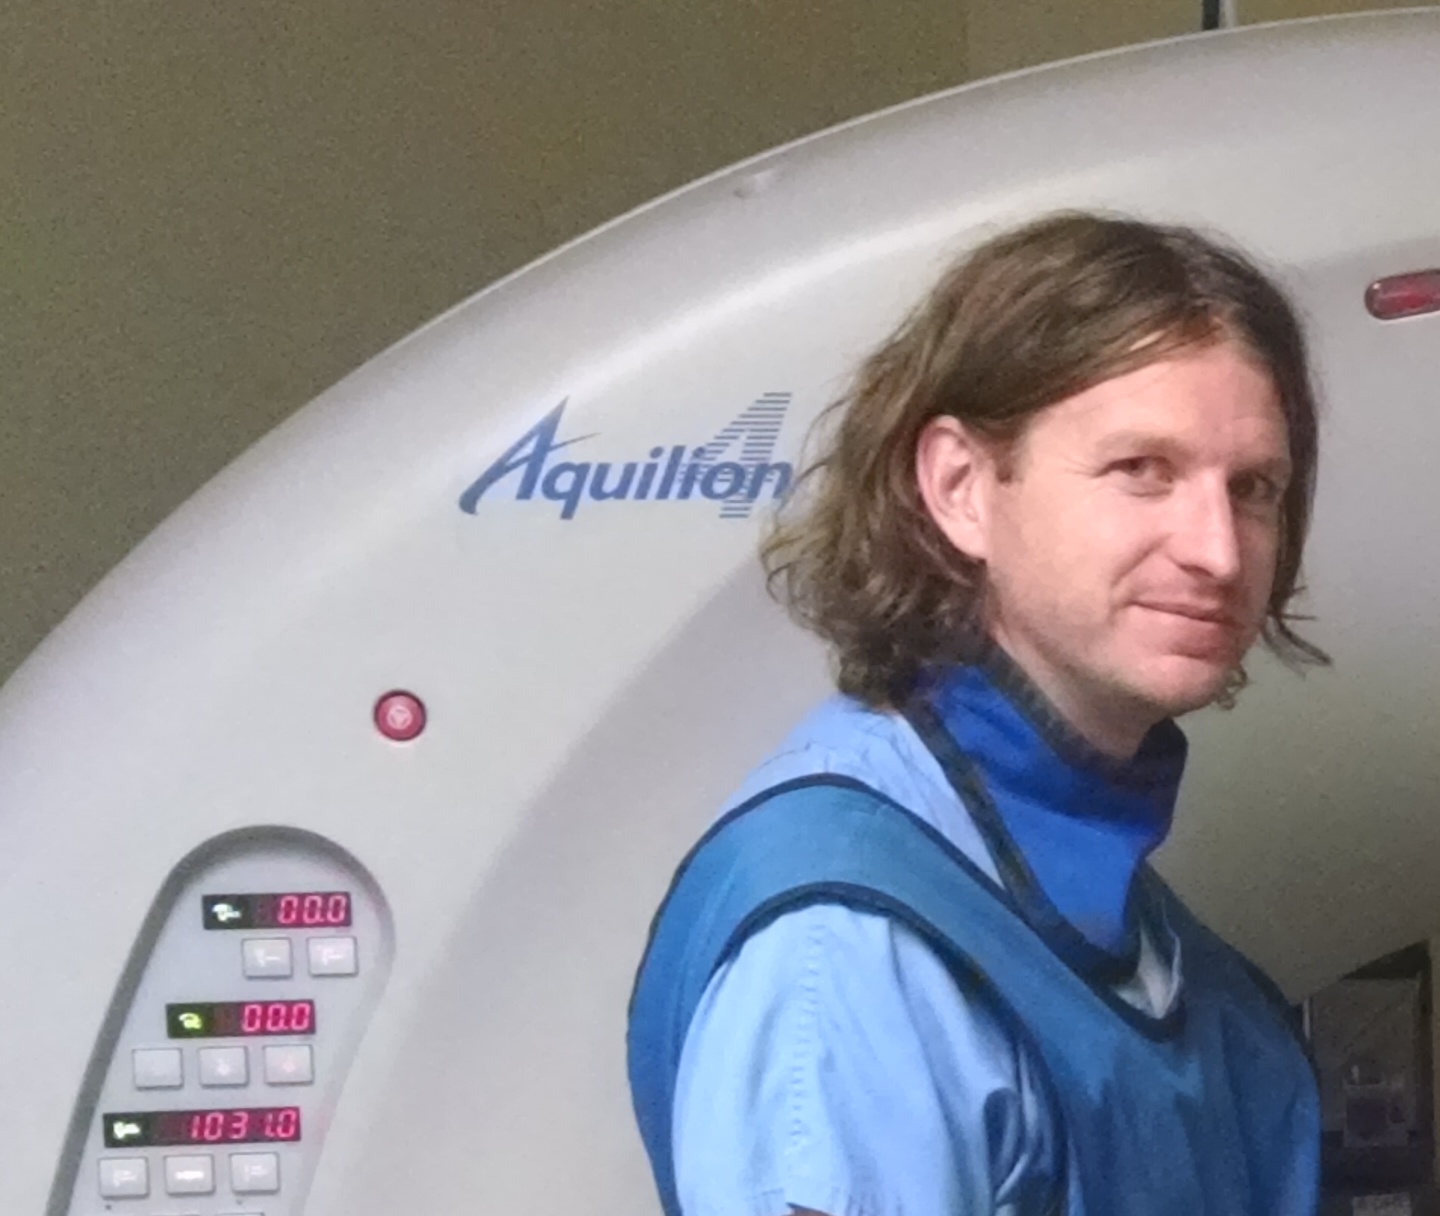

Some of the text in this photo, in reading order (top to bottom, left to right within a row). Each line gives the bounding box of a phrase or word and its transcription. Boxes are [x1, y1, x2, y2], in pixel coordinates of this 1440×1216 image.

[458, 395, 794, 520] Aquilion
[277, 895, 348, 925] 00.0
[241, 1003, 311, 1033] 00.0
